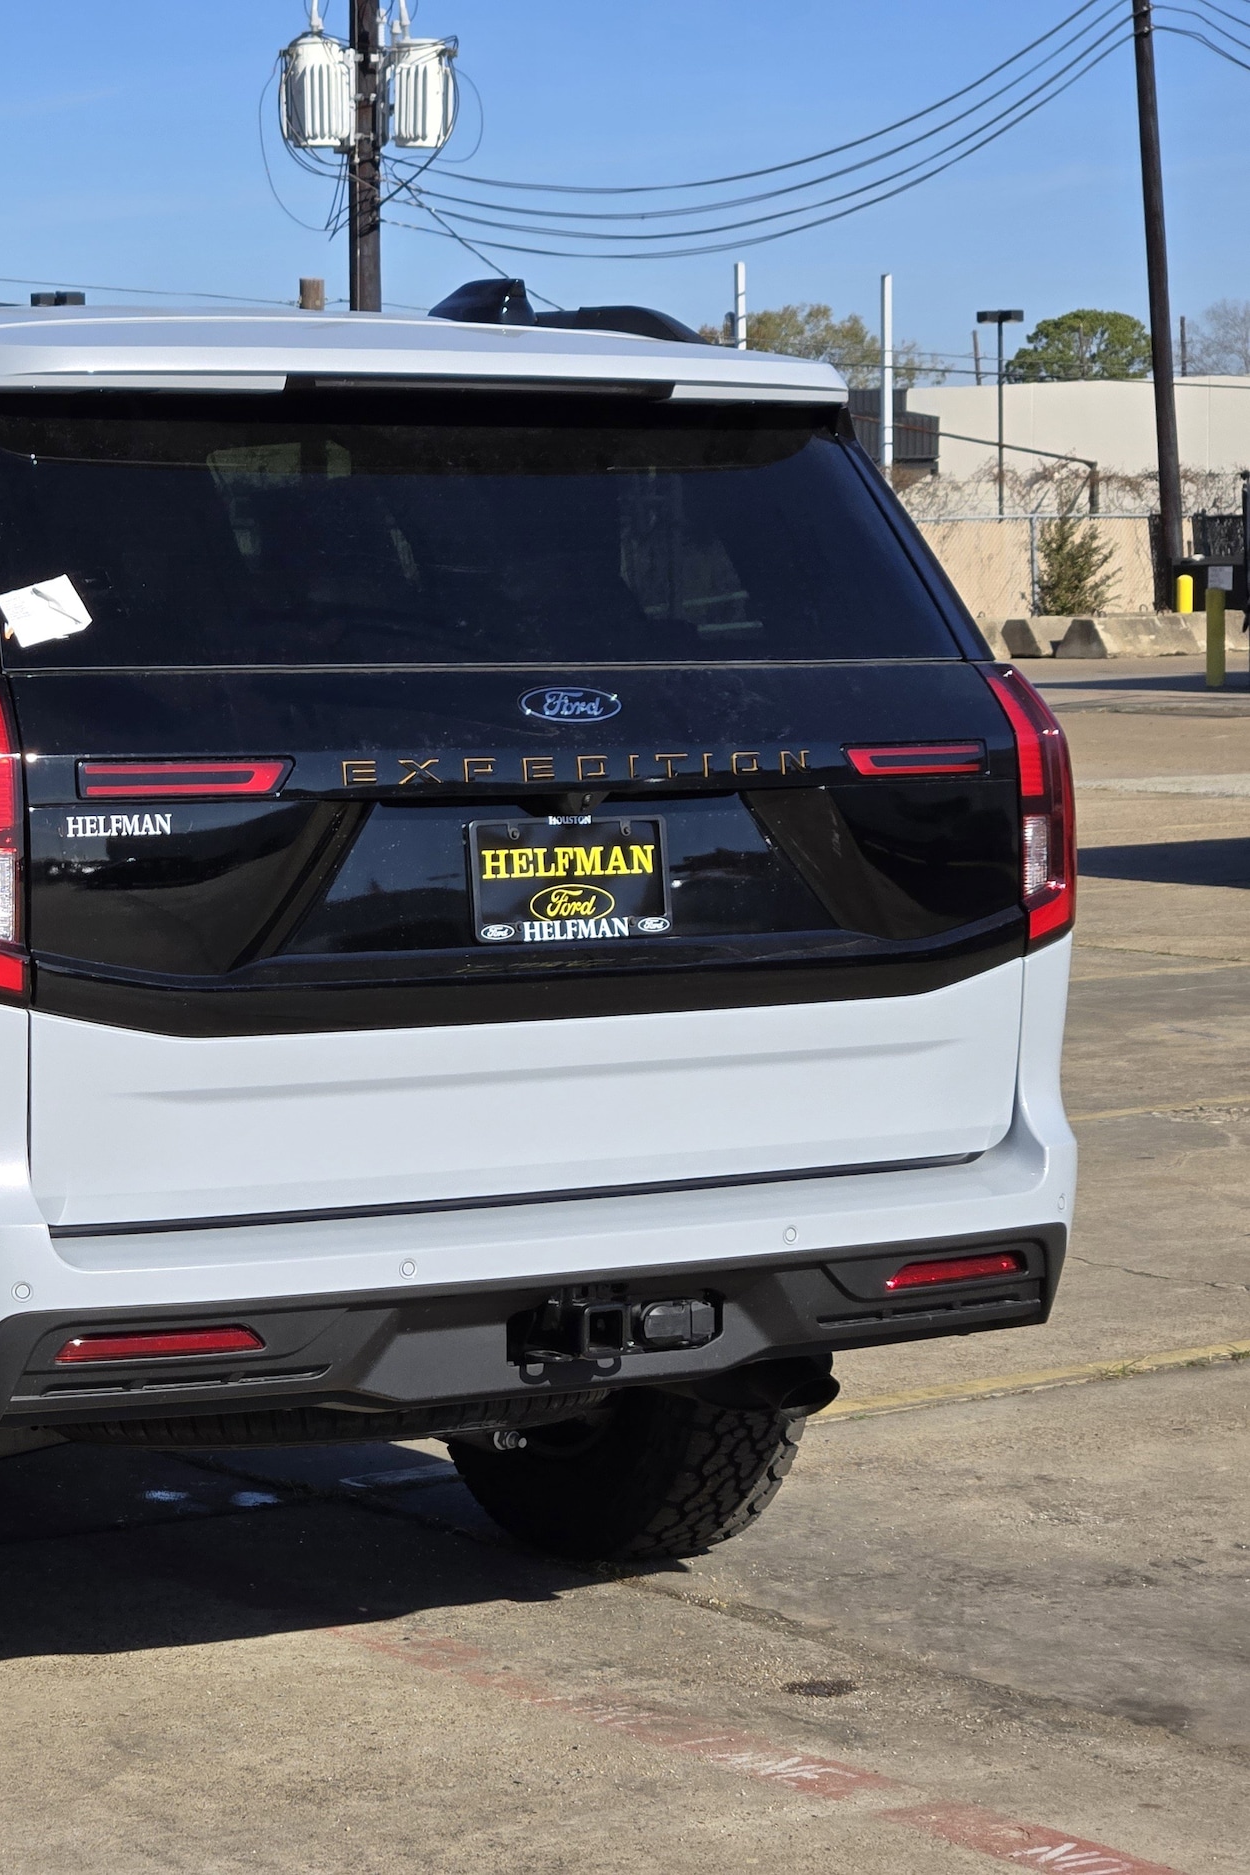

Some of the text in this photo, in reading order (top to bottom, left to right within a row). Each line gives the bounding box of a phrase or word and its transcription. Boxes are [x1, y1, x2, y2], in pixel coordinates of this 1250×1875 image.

[543, 690, 603, 716] Ford
[341, 751, 810, 786] EXPEDITION
[66, 814, 172, 838] HELFMAN
[548, 815, 591, 825] HOUSTON
[481, 845, 655, 879] HELFMAN
[546, 888, 596, 916] Ford
[522, 916, 630, 942] HELFMAN
